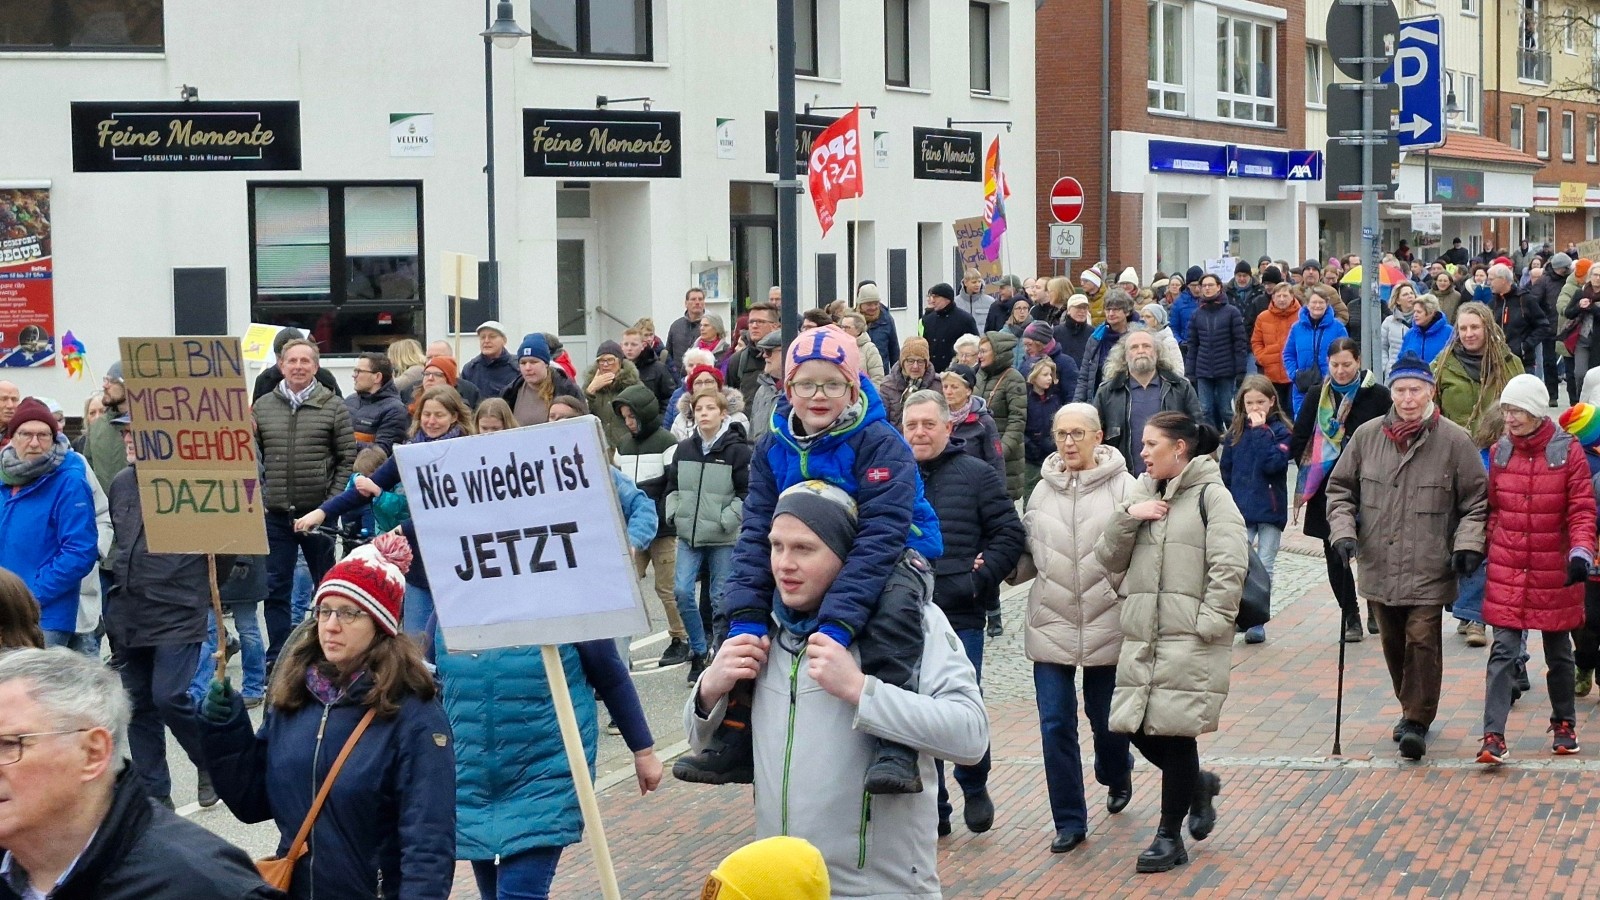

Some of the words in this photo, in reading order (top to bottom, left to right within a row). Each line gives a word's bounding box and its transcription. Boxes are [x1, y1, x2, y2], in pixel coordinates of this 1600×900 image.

[1394, 46, 1429, 111] P
[97, 119, 161, 148] Feine
[166, 119, 275, 148] Momente
[397, 135, 429, 144] VELTINS
[533, 126, 583, 153] Feine
[587, 127, 672, 154] Momente
[143, 154, 183, 162] ESSKULTUR
[921, 140, 942, 162] Feine
[942, 141, 976, 164] Momente
[1288, 165, 1313, 178] AXA
[960, 240, 973, 250] die
[960, 247, 987, 263] Karto
[127, 342, 178, 378] ICH
[183, 340, 242, 377] BIN
[126, 386, 247, 422] MIGRANT
[133, 429, 173, 461] UND
[176, 426, 254, 461] GEHÖR
[415, 463, 459, 510] Nie
[461, 451, 546, 504] wieder
[549, 442, 590, 492] ist
[150, 478, 257, 514] DAZU!
[454, 521, 579, 582] JETZT
